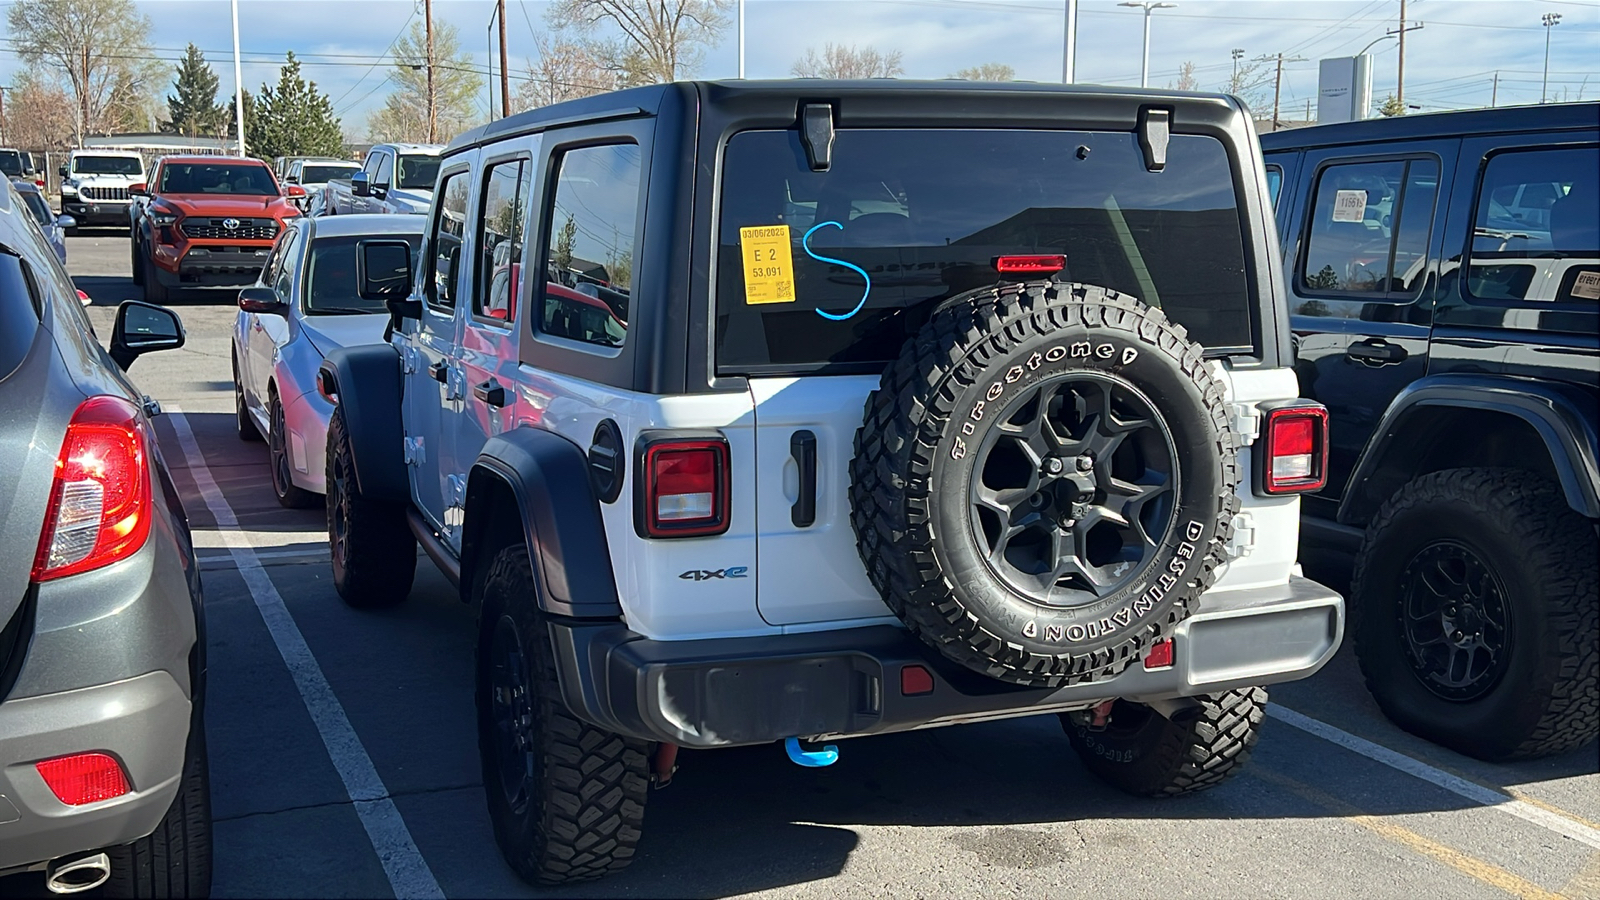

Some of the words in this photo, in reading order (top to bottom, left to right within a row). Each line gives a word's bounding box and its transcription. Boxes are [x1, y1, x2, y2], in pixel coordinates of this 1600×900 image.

[752, 266, 782, 279] 53,091
[754, 249, 762, 262] E
[769, 248, 776, 261] 2
[803, 220, 871, 321] S
[951, 341, 1116, 460] Firestone
[1043, 520, 1204, 642] DESTINATION
